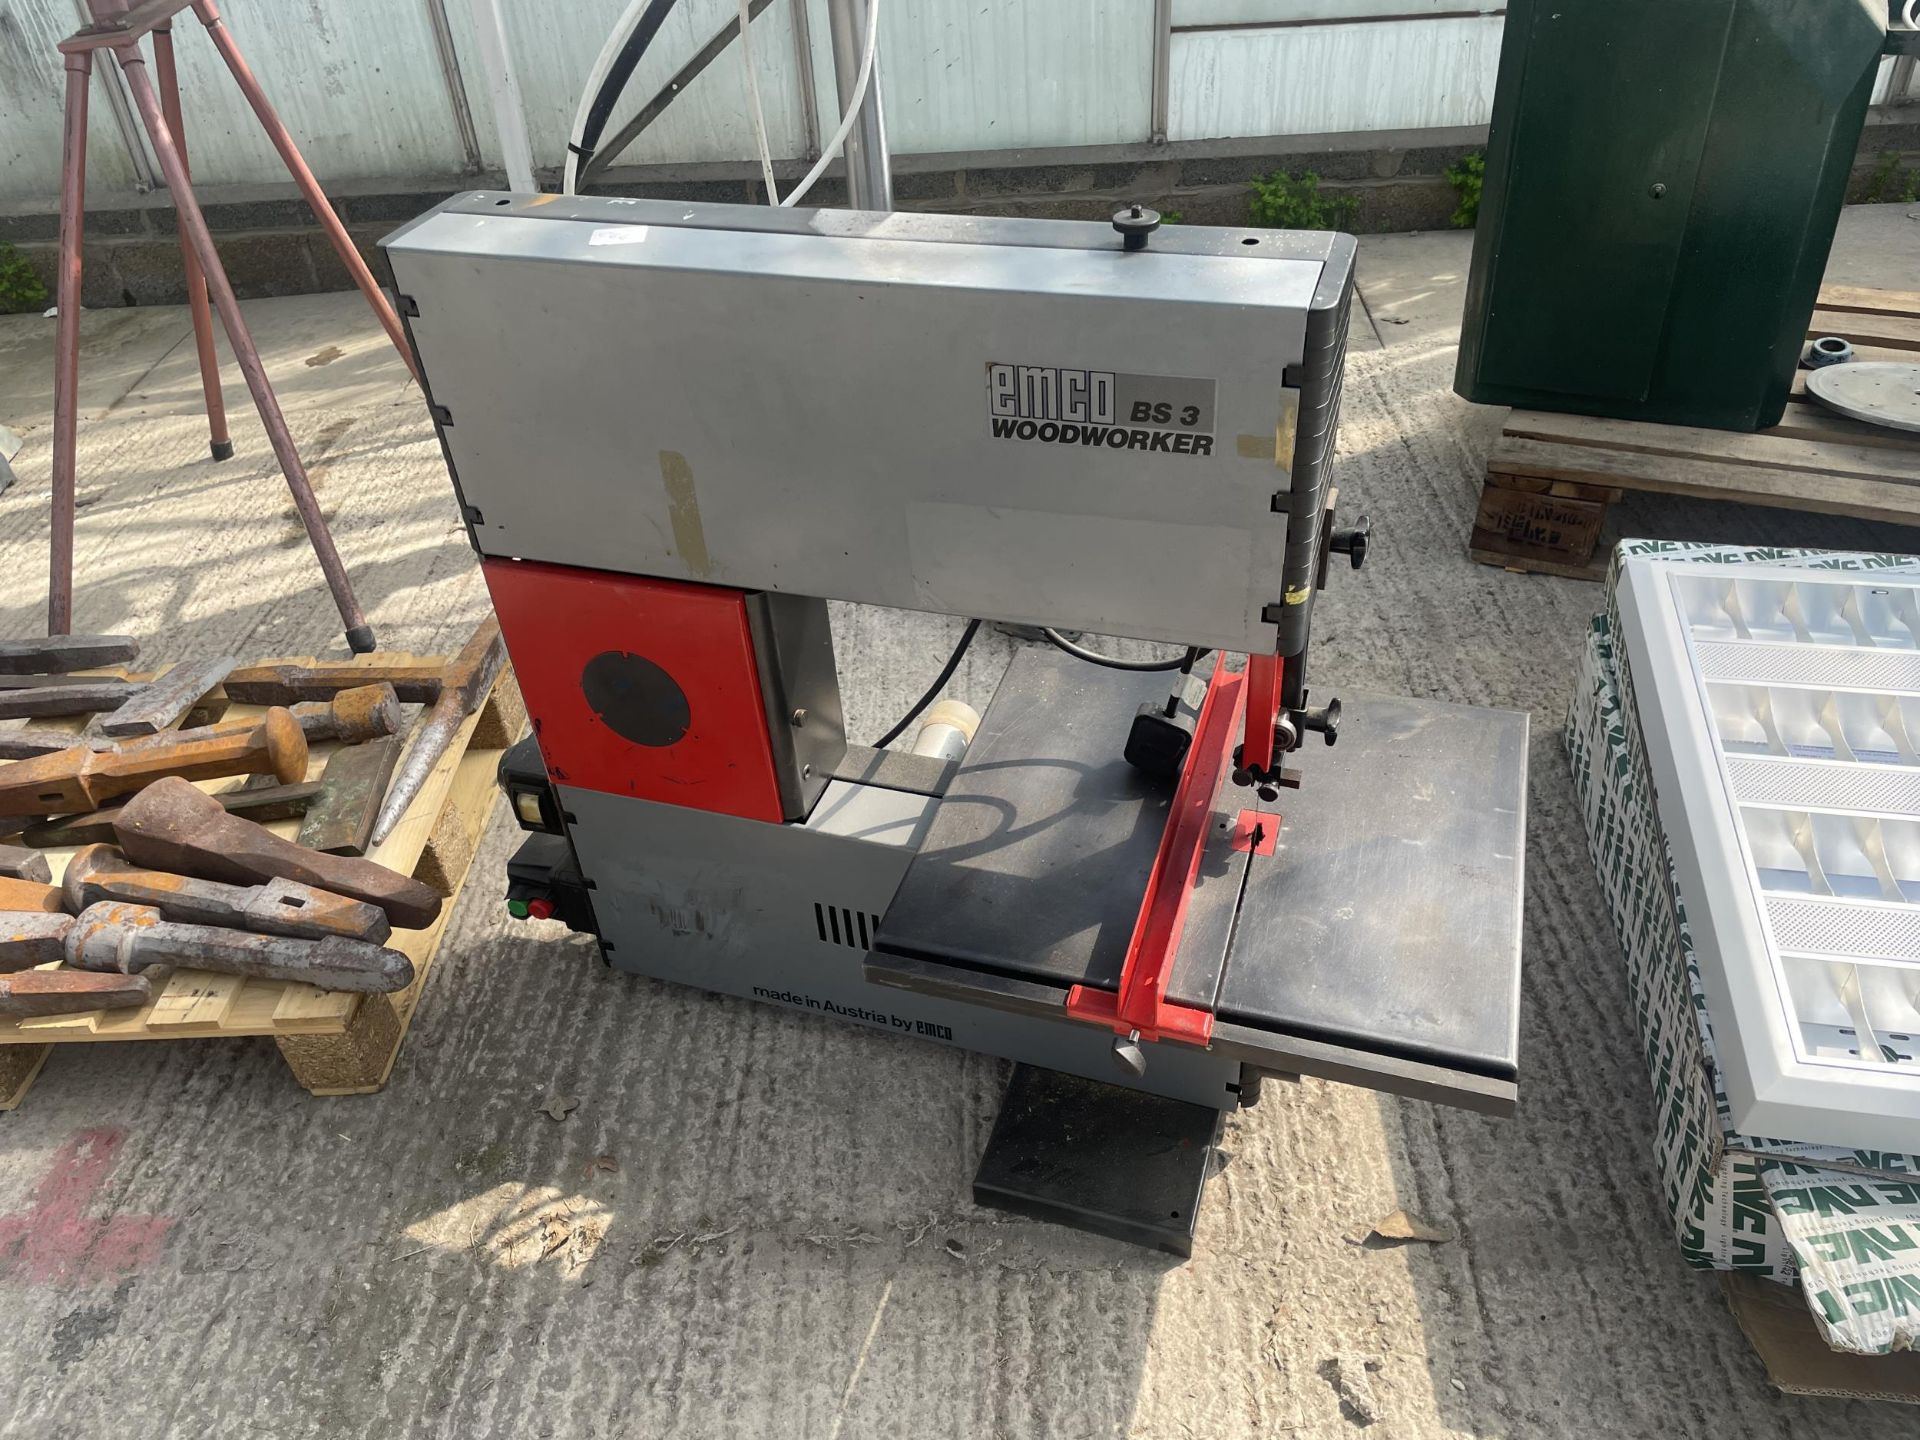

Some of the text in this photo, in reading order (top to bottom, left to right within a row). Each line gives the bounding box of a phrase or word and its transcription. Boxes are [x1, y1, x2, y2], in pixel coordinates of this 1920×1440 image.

[990, 364, 1200, 427] emco BS 3
[991, 418, 1214, 456] WOODWORKER
[753, 986, 803, 1006] made
[805, 995, 821, 1010] in
[823, 1000, 887, 1025] Austria
[891, 1014, 912, 1032] by
